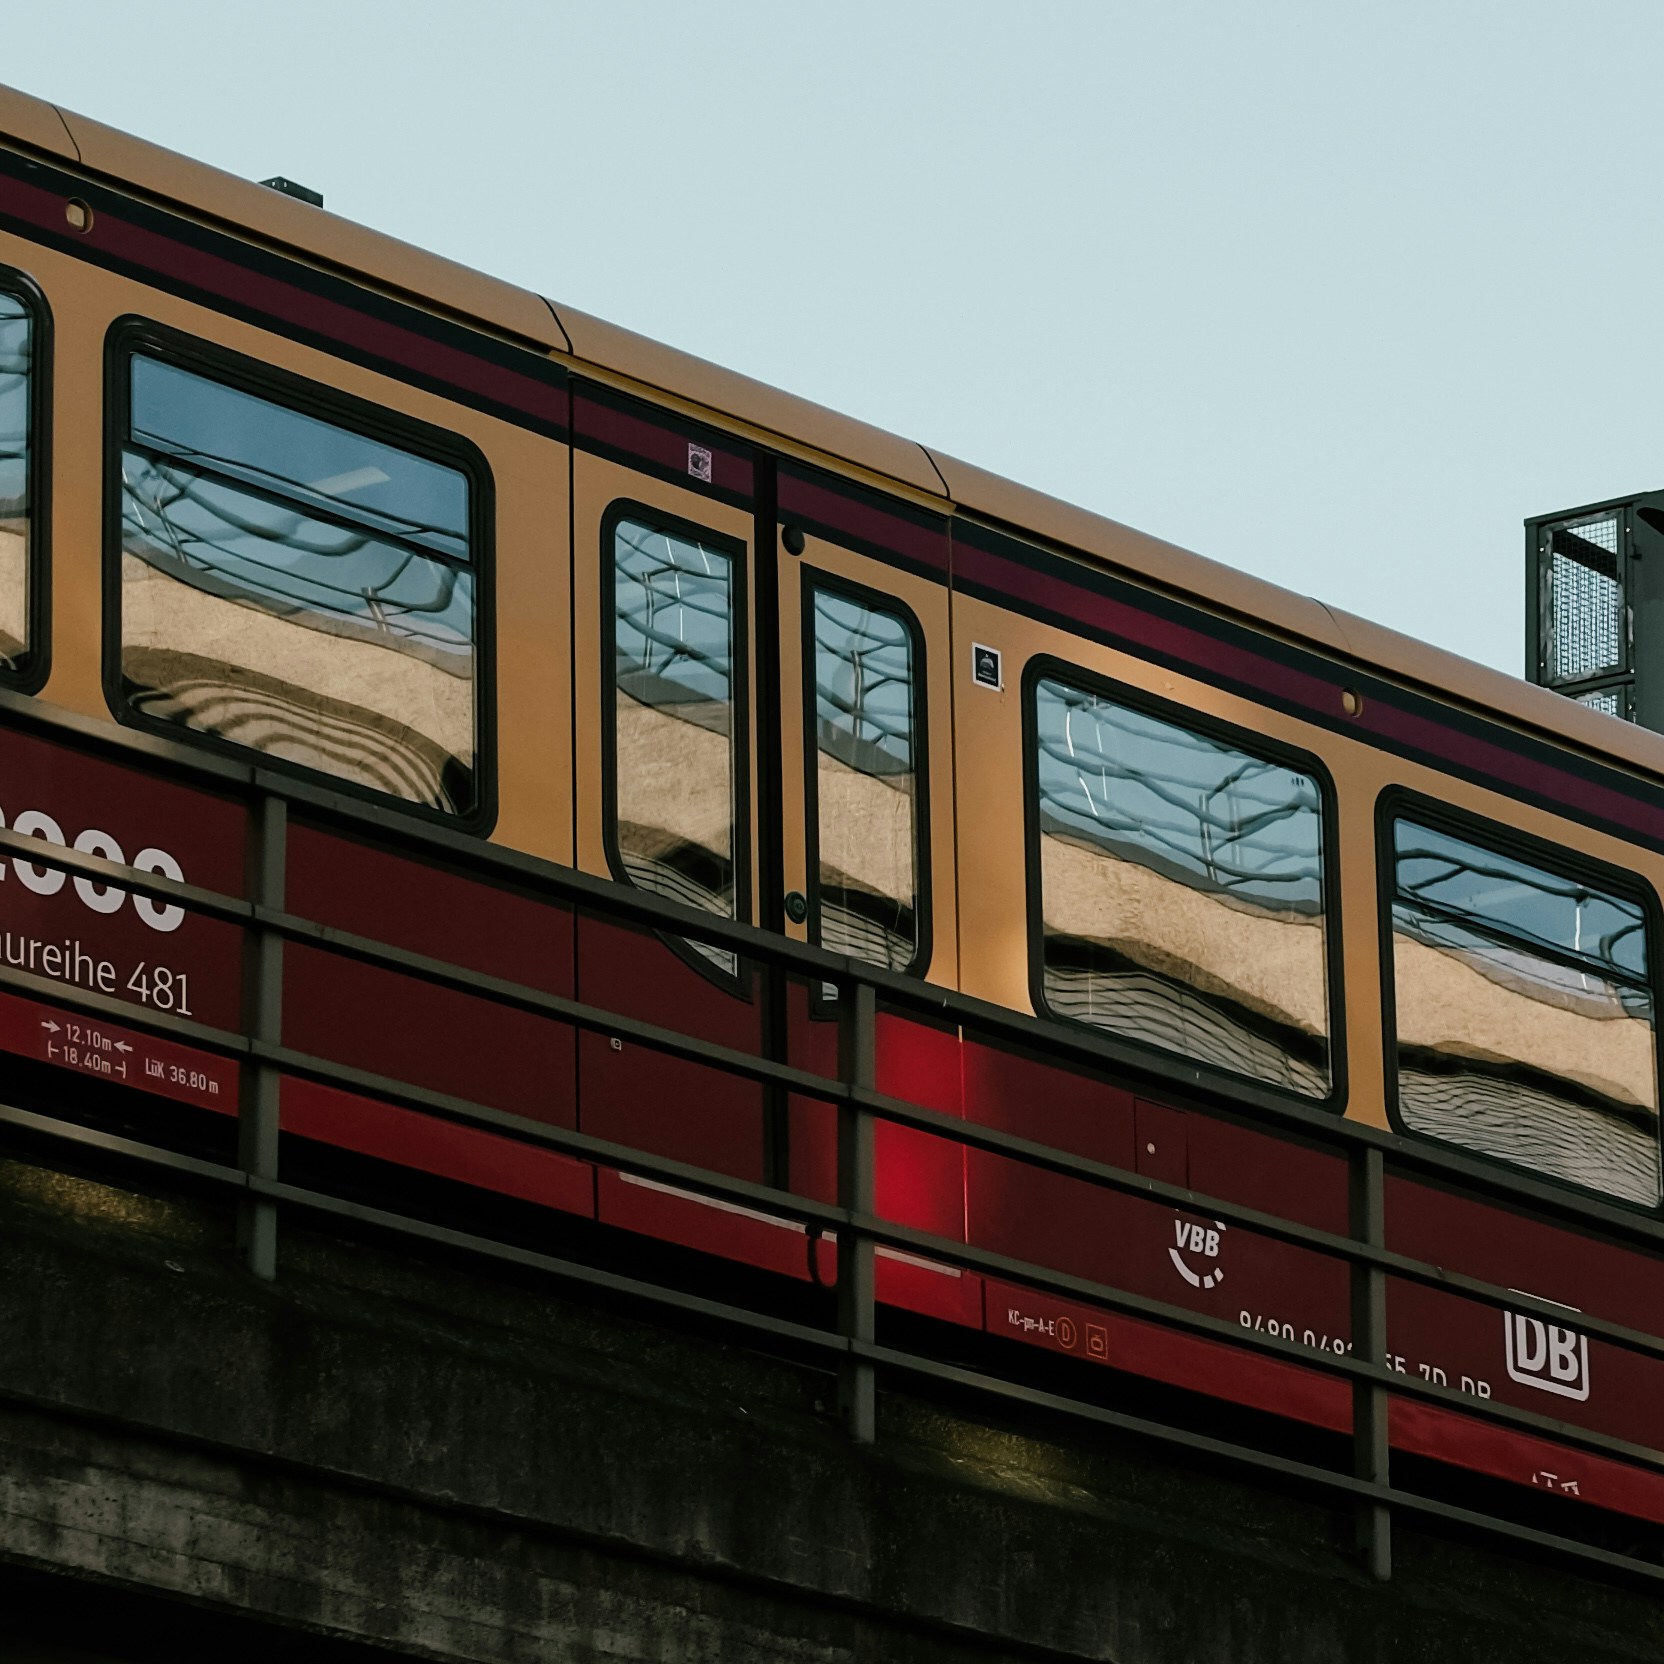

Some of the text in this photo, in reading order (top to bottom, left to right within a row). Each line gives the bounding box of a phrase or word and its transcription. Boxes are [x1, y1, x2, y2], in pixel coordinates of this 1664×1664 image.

[0, 804, 186, 932] 000
[0, 932, 193, 1016] ureihe 481
[63, 1045, 111, 1075] 18.40m
[65, 1023, 112, 1052] 12.10m
[1175, 1219, 1220, 1257] VBB
[1515, 1313, 1579, 1382] DB
